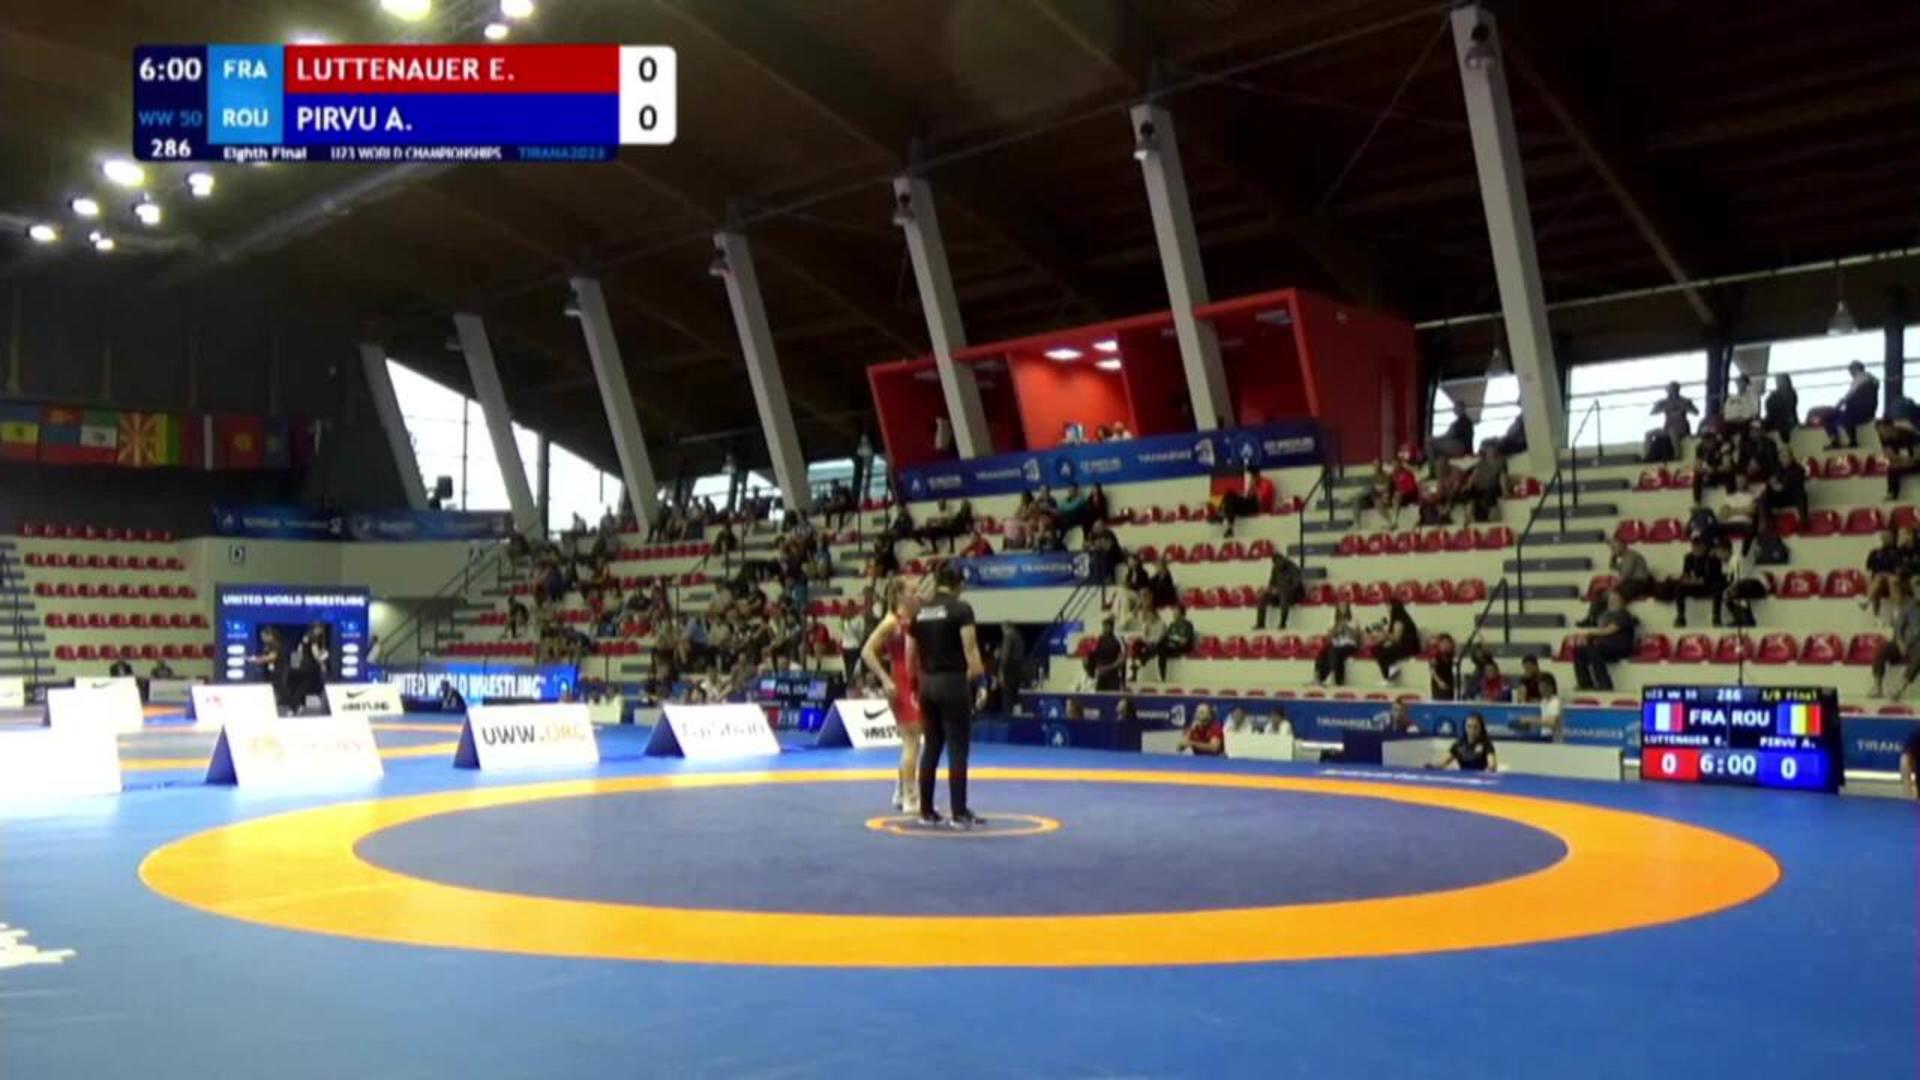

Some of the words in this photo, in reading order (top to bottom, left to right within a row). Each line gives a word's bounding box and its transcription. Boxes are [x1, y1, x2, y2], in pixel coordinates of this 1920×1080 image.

[1689, 709, 1726, 725] FRA
[1732, 710, 1770, 727] ROU
[1661, 753, 1677, 774] 0
[1700, 753, 1757, 776] 6:00
[1781, 757, 1797, 780] 0
